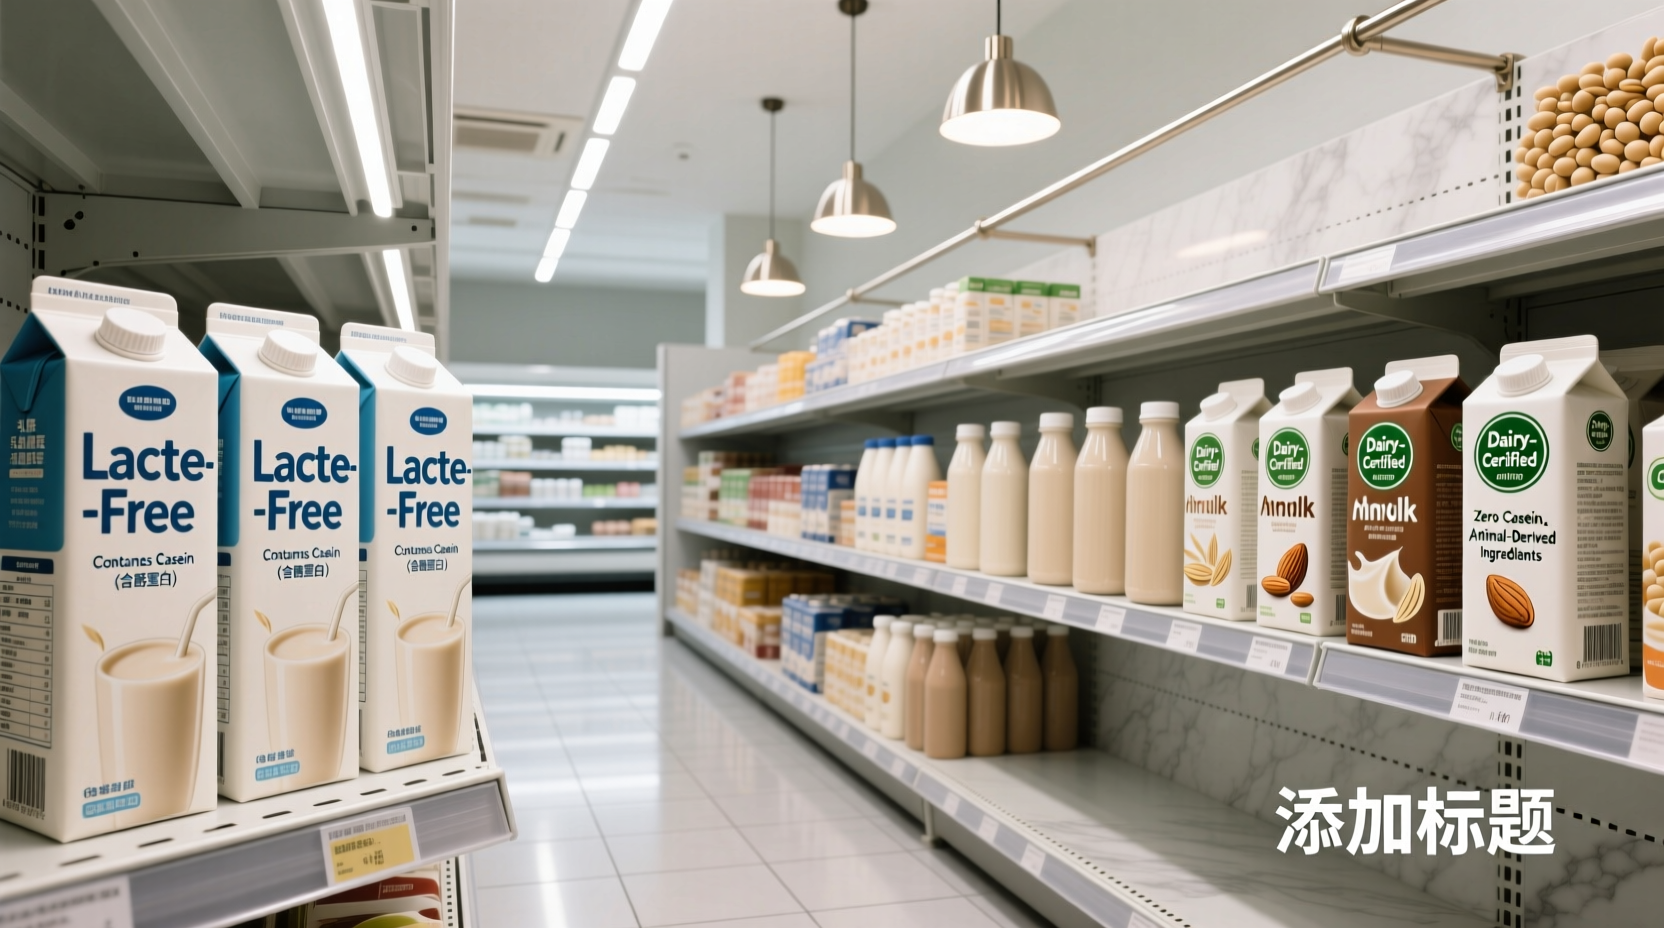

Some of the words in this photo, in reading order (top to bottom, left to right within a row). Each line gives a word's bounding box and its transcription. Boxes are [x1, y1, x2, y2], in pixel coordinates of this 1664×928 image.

[83, 432, 214, 482] Lacte-
[1273, 441, 1304, 457] Dairy-
[1366, 435, 1406, 454] Dairy-
[1487, 430, 1537, 450] Dairy-
[253, 439, 357, 483] Lacte-
[386, 446, 472, 485] Lacte-
[83, 489, 195, 534] -Free
[253, 490, 342, 530] -Free
[387, 491, 460, 528] -Free
[1474, 509, 1499, 523] Zero
